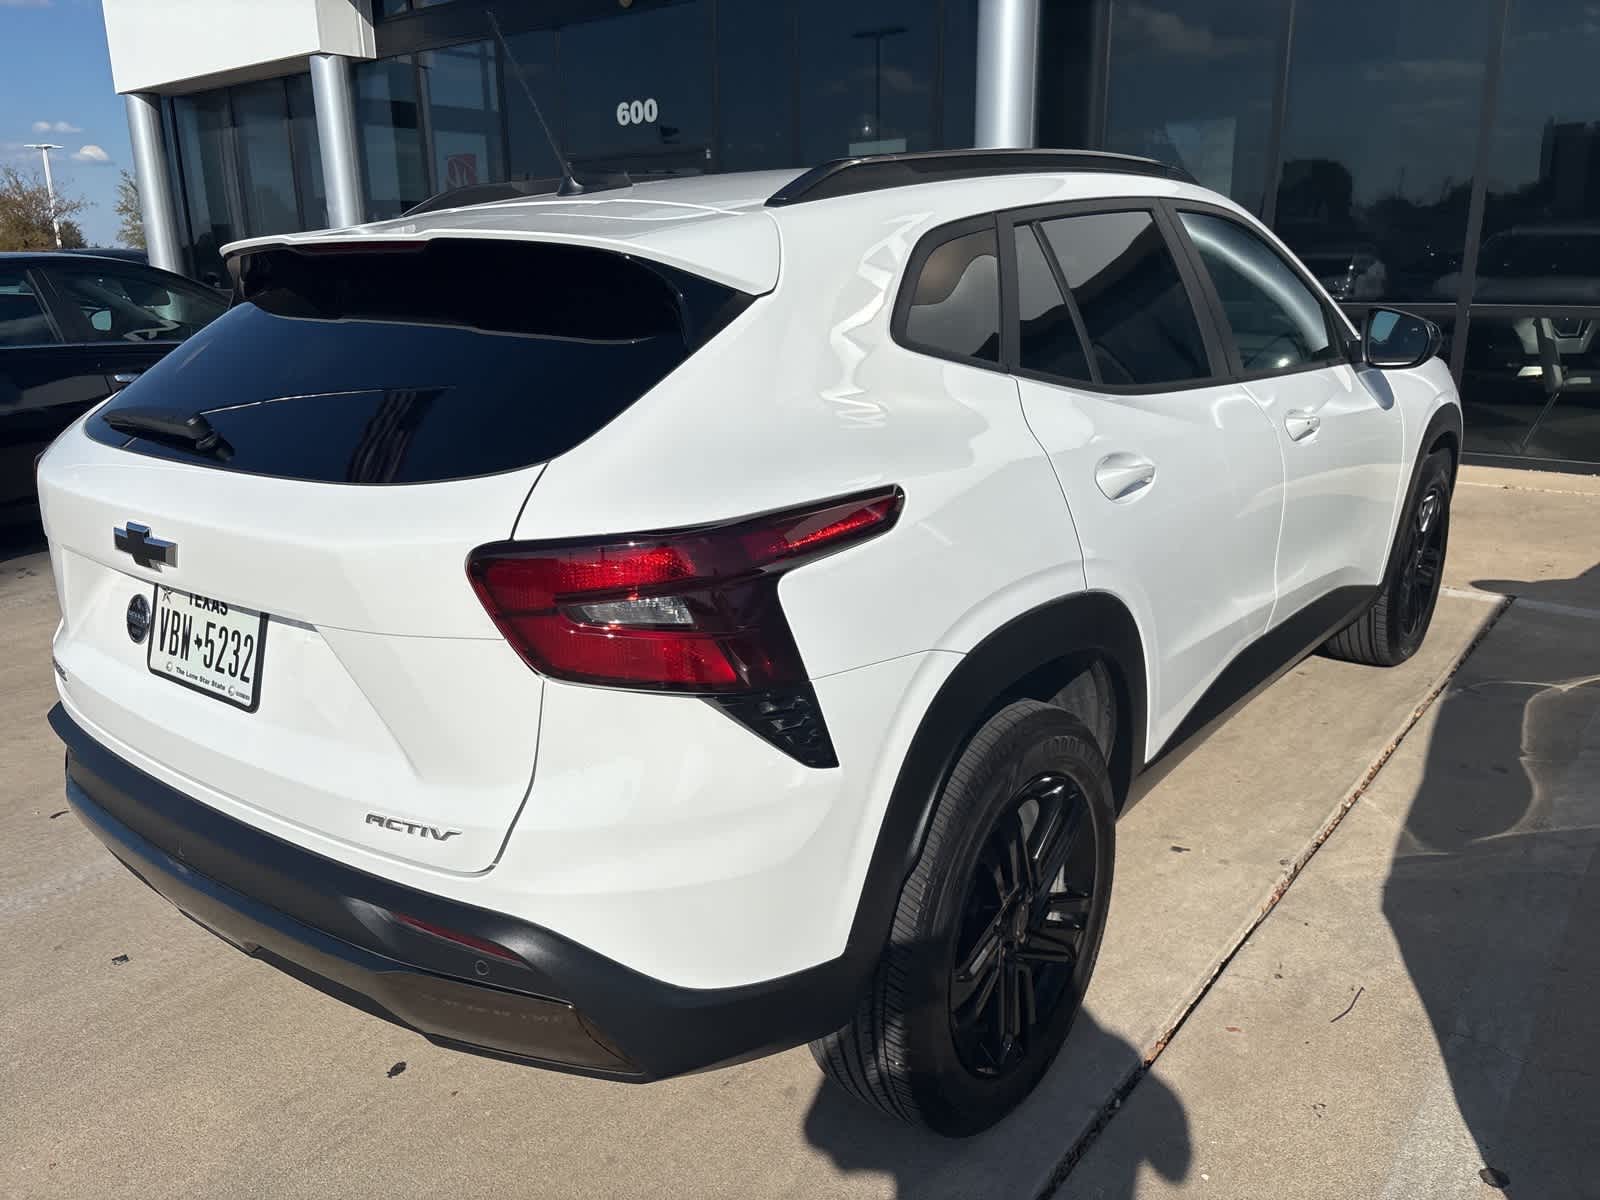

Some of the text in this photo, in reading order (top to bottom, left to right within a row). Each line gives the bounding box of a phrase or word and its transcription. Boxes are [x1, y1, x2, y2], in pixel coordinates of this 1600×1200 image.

[616, 98, 658, 126] 600
[190, 593, 228, 616] TEXAS
[176, 666, 226, 690] The Lone Star State
[365, 813, 462, 841] ACTIV
